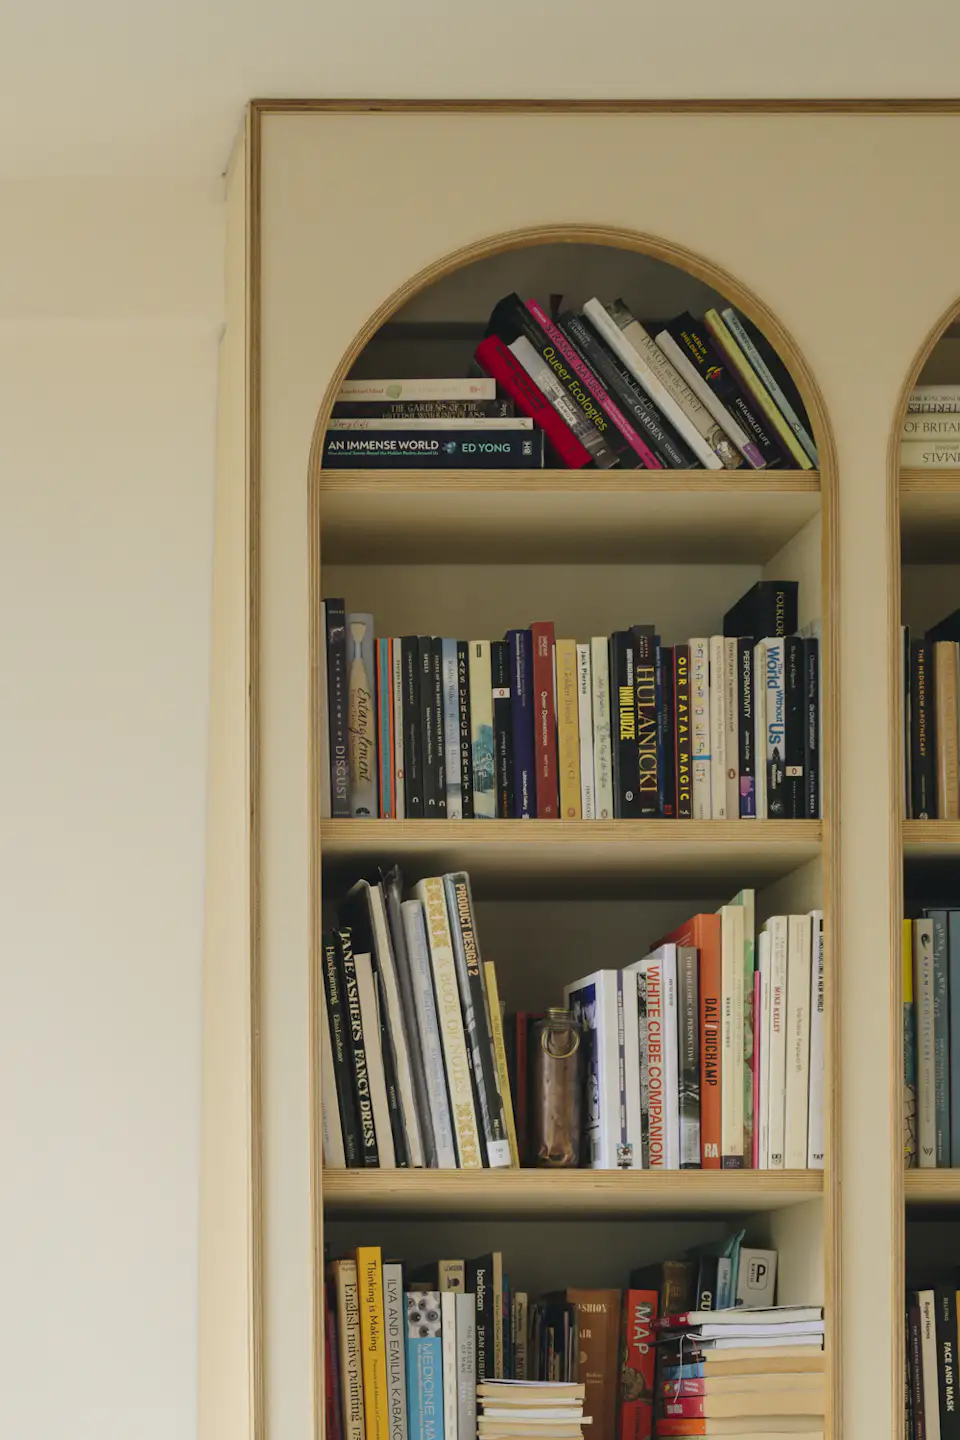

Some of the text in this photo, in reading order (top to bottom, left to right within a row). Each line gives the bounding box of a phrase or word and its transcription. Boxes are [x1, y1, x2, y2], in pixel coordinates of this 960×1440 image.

[543, 322, 578, 363] STRANGE
[574, 361, 609, 402] NATURES
[679, 330, 704, 364] SHELDRAKE
[689, 331, 707, 355] MERLIN
[540, 345, 573, 383] Queer
[565, 379, 611, 432] Ecologies
[639, 335, 668, 368] IMAGE
[670, 375, 683, 388] the
[679, 386, 702, 413] EDGE
[392, 404, 477, 412] THE GARDENS OF THE
[632, 403, 664, 442] GARDEN
[735, 397, 761, 434] ENTANGLED
[758, 432, 770, 447] LIFE
[904, 421, 919, 432] OF
[328, 440, 438, 450] AN IMMENSE WORLD
[462, 442, 510, 452] ED YONG
[663, 441, 682, 464] OXFORD
[774, 591, 785, 634] FOLKLOR
[564, 667, 573, 695] Golden
[742, 650, 750, 717] PERFORMATIVITY
[766, 646, 780, 689] World
[459, 689, 467, 736] ULRICH
[620, 707, 634, 740] LUDZIE
[775, 690, 783, 722] Without
[336, 731, 341, 741] OF
[347, 687, 373, 783] Entanglement
[636, 665, 657, 792] HULANICKI
[677, 657, 689, 800] OUR FATAL MAGIC
[767, 723, 784, 744] Us
[334, 745, 346, 799] DISGUST
[695, 762, 705, 783] CITY
[454, 882, 471, 928] PRODUCT
[461, 930, 477, 967] DESIGN
[325, 946, 340, 1005] Handspinning
[436, 956, 467, 1094] A BOOK OF NOTES
[686, 1007, 692, 1016] OF
[338, 927, 375, 1147] JANE ASHER'S FANCY DRESS
[704, 998, 718, 1085] DALÍ/DUCHAMP
[646, 966, 662, 1165] WHITE CUBE COMPANION
[704, 1143, 719, 1158] RA
[365, 1260, 377, 1303] Thinking
[386, 1278, 396, 1303] ILYA
[476, 1269, 484, 1310] barbican
[756, 1264, 766, 1282] P
[343, 1283, 359, 1330] English
[388, 1308, 398, 1335] AND
[922, 1302, 930, 1318] Roger
[347, 1334, 360, 1366] naive
[367, 1315, 379, 1352] Making
[632, 1305, 650, 1354] MAP
[389, 1340, 400, 1383] EMILIA
[421, 1343, 434, 1416] MEDICINE
[943, 1341, 954, 1411] FACE AND MASK
[347, 1370, 363, 1421] painting
